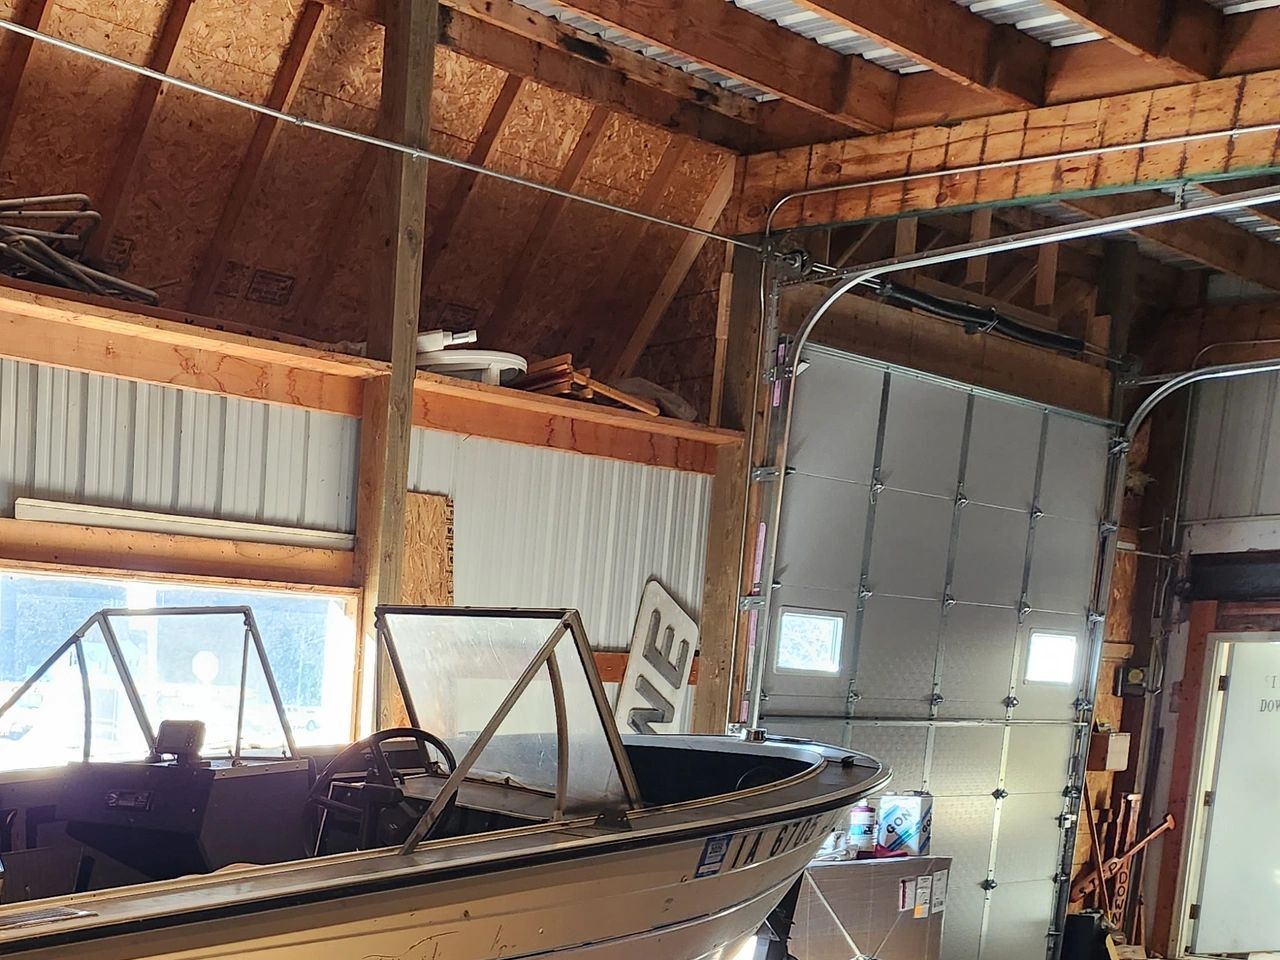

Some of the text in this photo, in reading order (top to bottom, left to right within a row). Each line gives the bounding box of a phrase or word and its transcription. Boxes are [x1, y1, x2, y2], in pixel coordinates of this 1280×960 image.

[732, 831, 765, 869] IA
[1079, 861, 1118, 897] STP
[1111, 870, 1128, 925] DOWN
